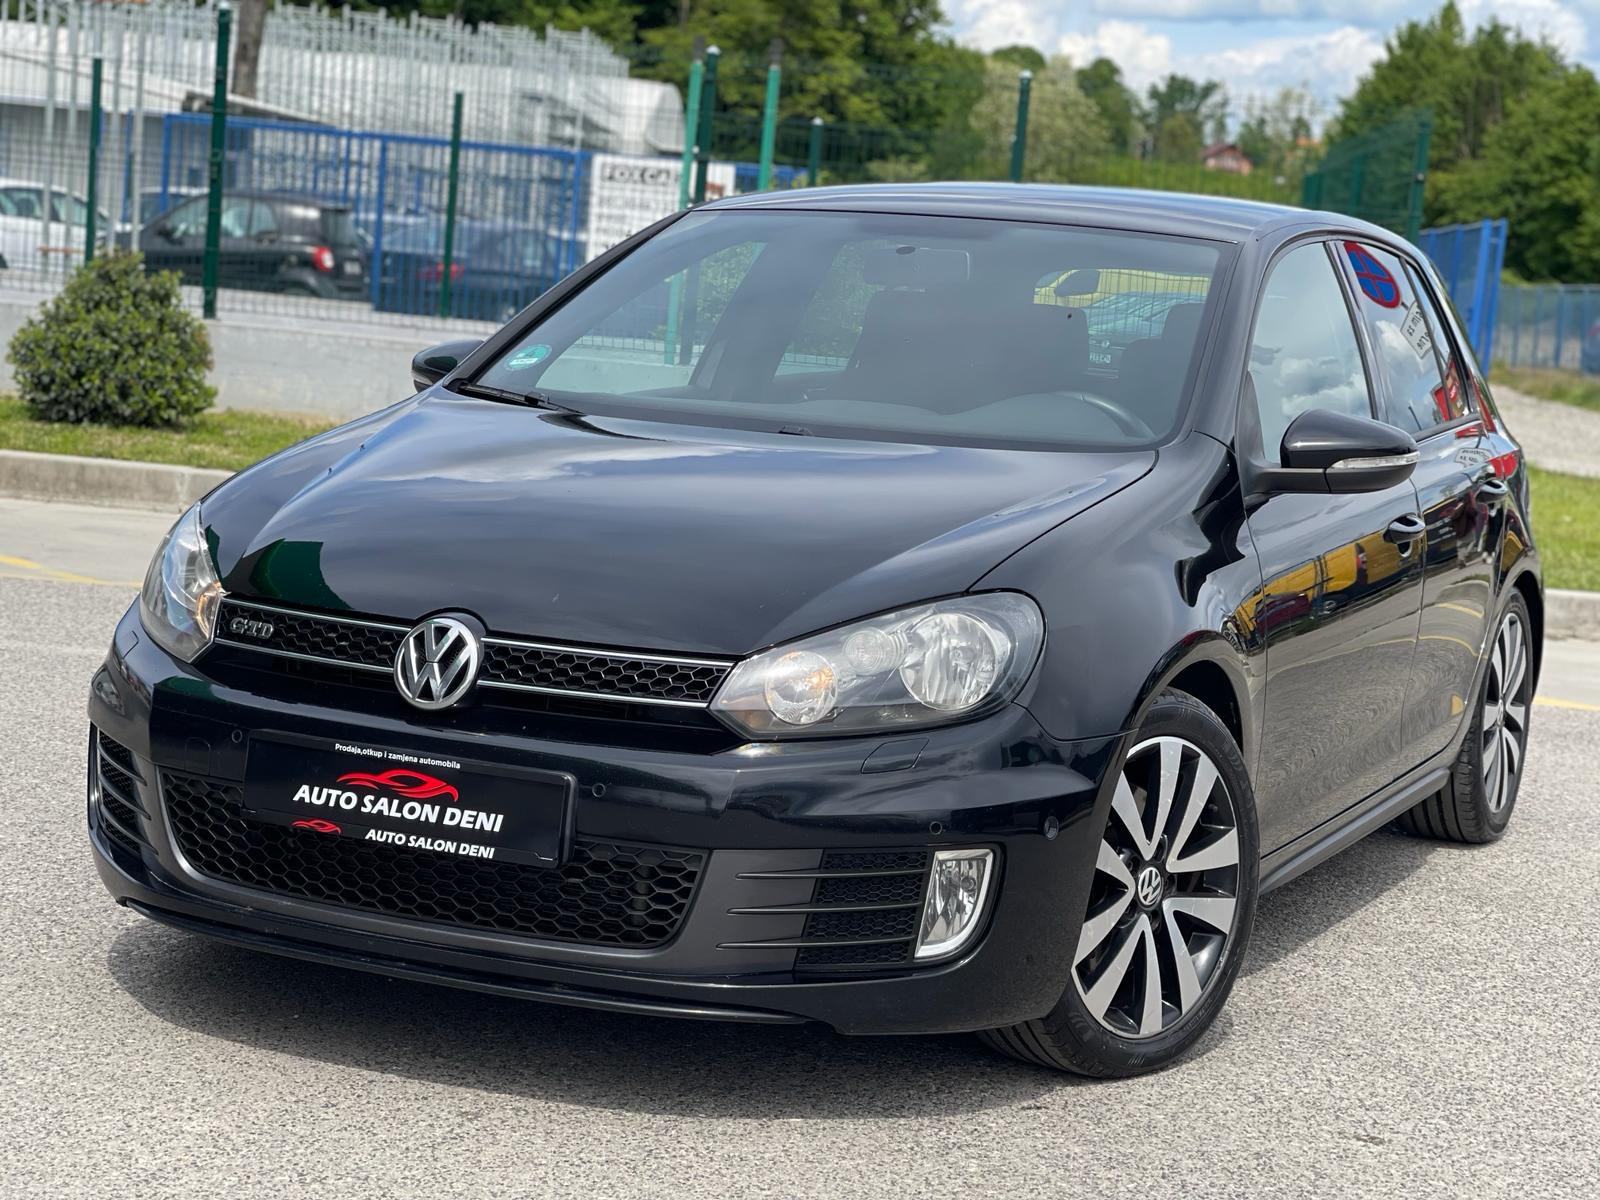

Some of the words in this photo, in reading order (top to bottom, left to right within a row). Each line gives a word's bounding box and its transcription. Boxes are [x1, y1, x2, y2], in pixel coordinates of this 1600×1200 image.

[601, 163, 682, 187] FOXCA
[229, 616, 275, 640] GTD
[395, 617, 480, 709] VW
[334, 743, 383, 759] Prodaja,otkup
[388, 753, 419, 763] zamjena
[419, 757, 461, 769] automobila
[293, 784, 358, 811] AUTO
[360, 794, 440, 824] SALON
[442, 807, 504, 833] DENI
[364, 829, 406, 845] AUTO
[407, 835, 457, 854] SALON
[458, 842, 495, 859] DENI
